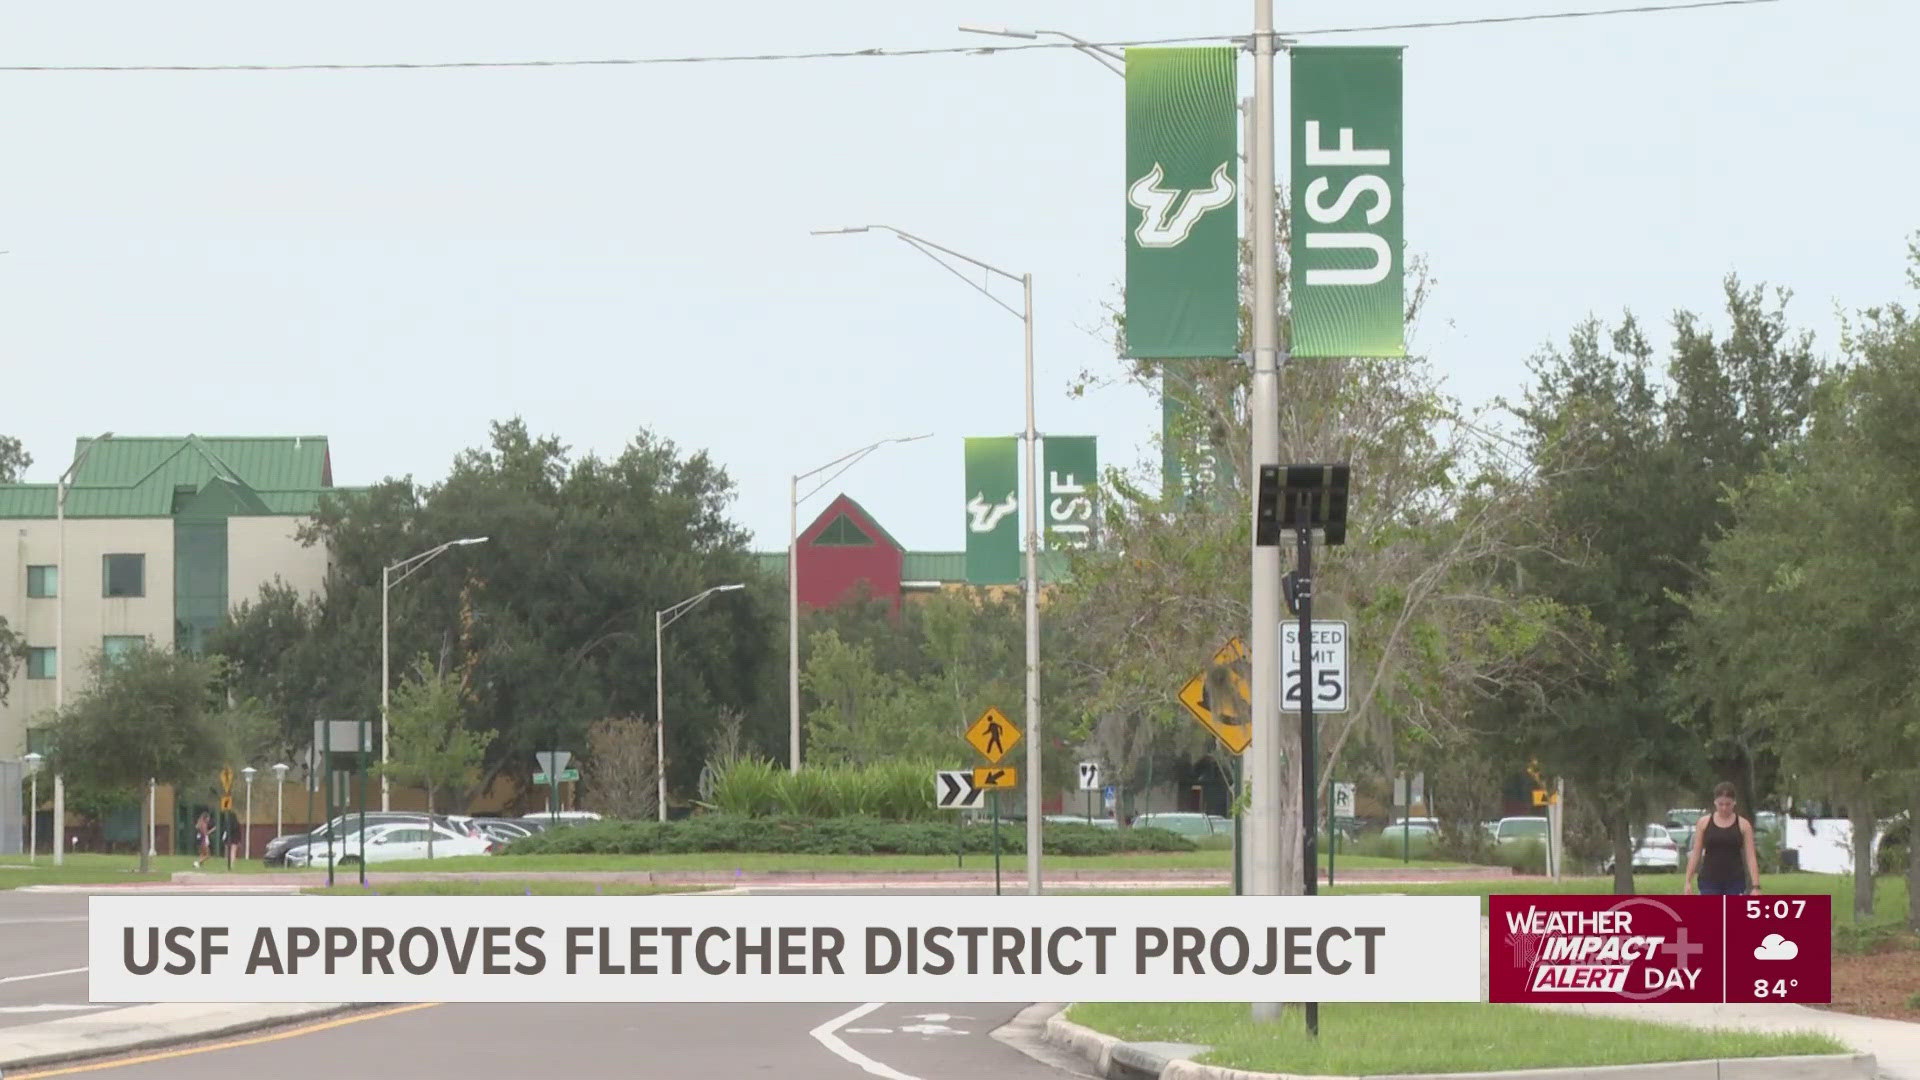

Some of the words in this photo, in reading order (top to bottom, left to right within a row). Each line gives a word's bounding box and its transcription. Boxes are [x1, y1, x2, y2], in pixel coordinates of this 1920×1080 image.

[1305, 120, 1392, 286] USF
[1286, 631, 1342, 644] SEED
[1292, 650, 1335, 663] LMIT
[1286, 669, 1342, 702] 25
